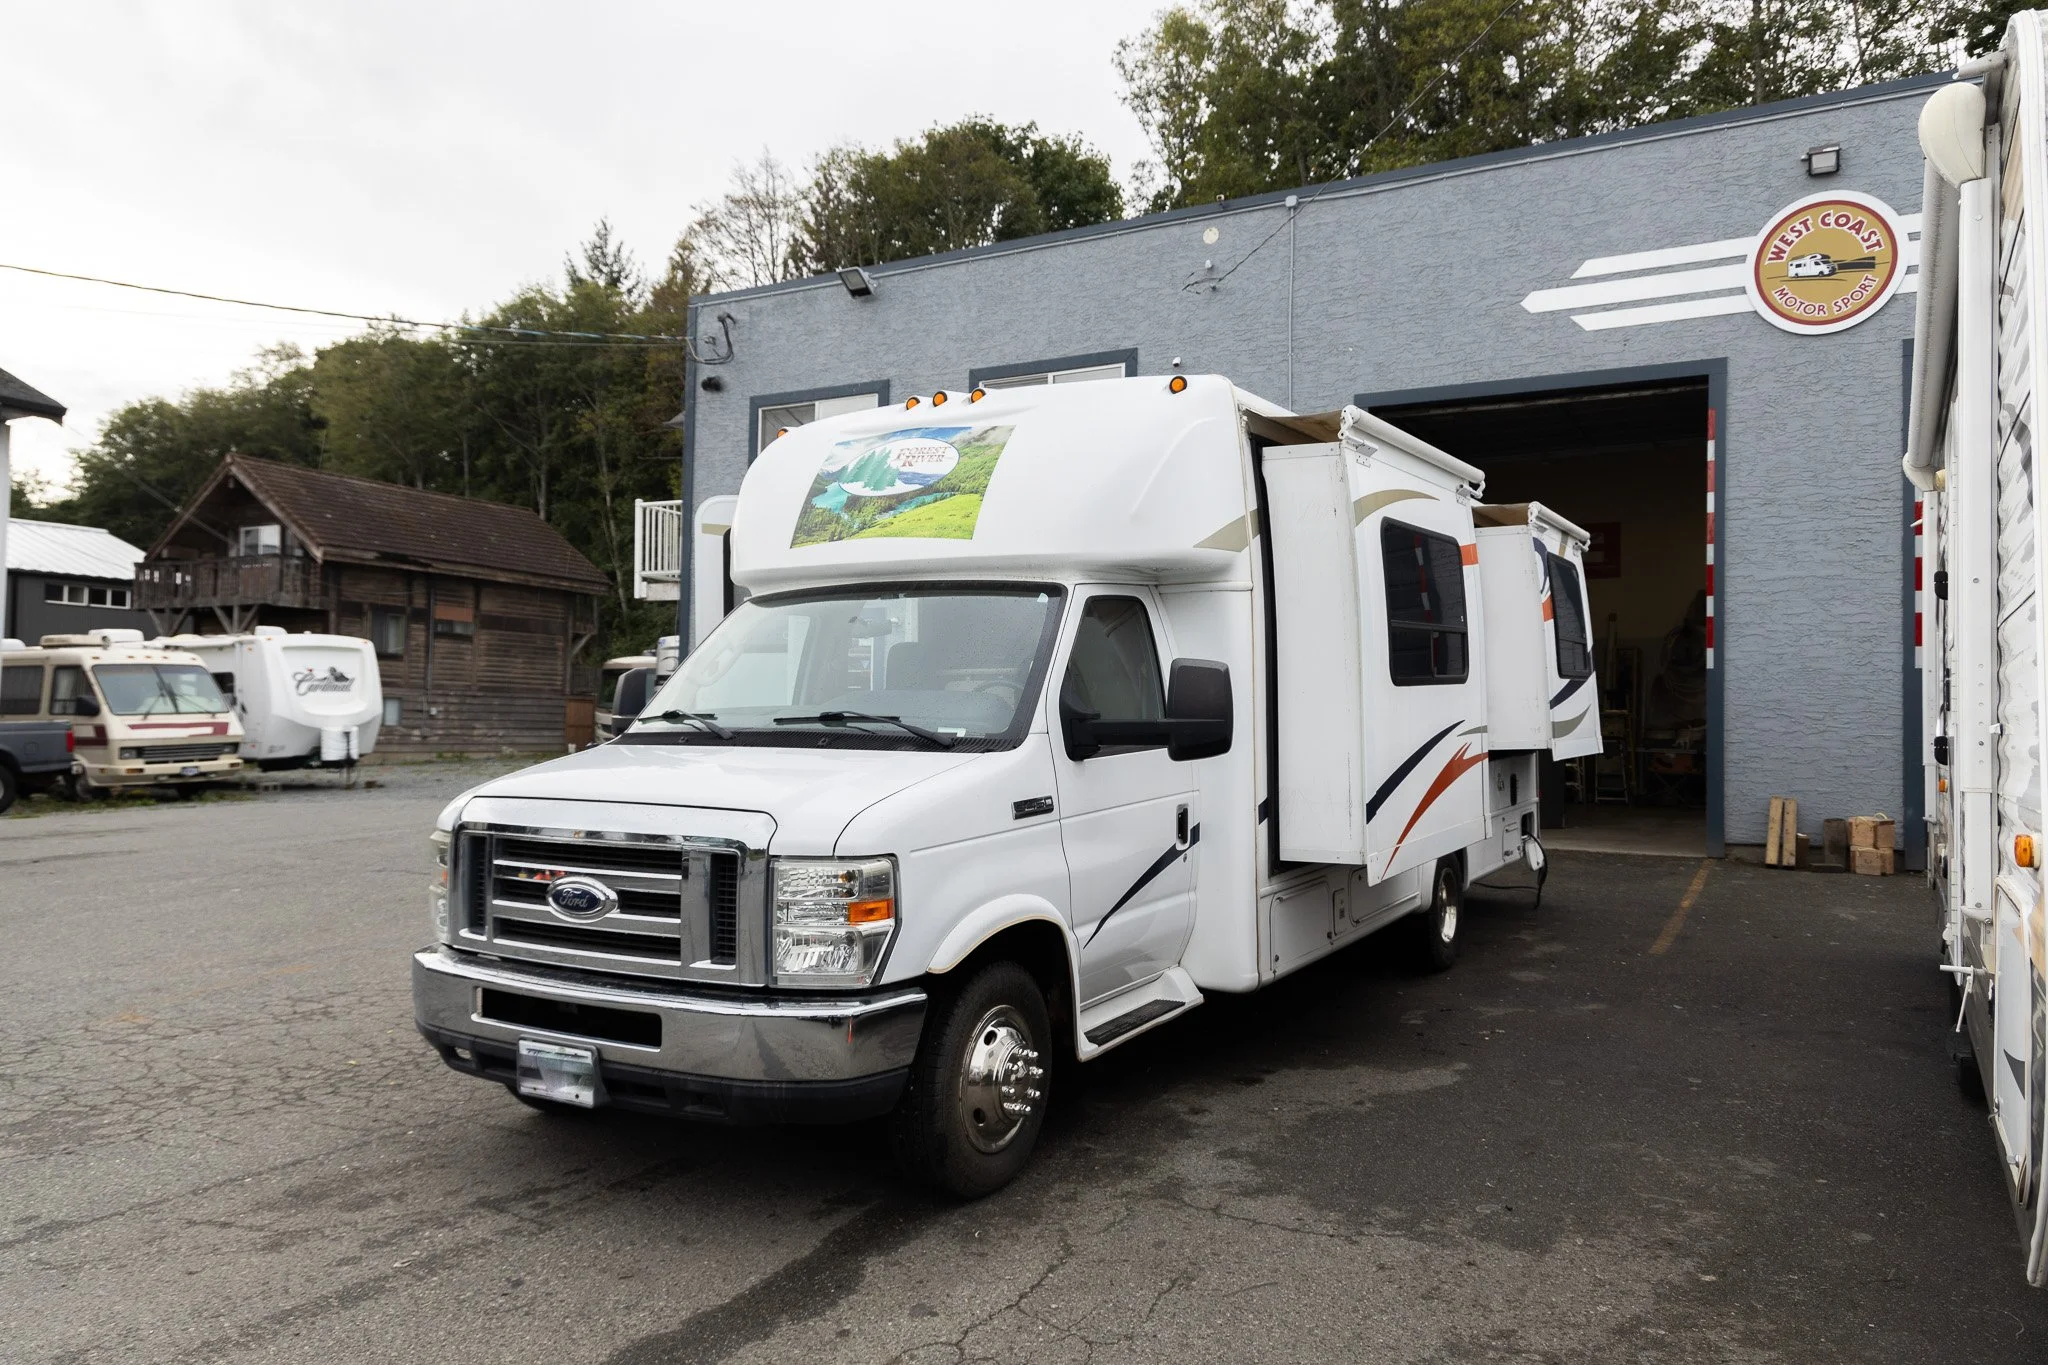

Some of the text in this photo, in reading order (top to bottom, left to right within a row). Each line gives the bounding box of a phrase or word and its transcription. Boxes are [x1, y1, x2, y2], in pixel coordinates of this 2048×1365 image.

[1767, 211, 1884, 262] WEST COAST
[1773, 275, 1879, 315] MOTOR SPORT
[896, 446, 952, 460] FOREST
[901, 455, 946, 467] RIVER
[560, 888, 589, 908] Ford
